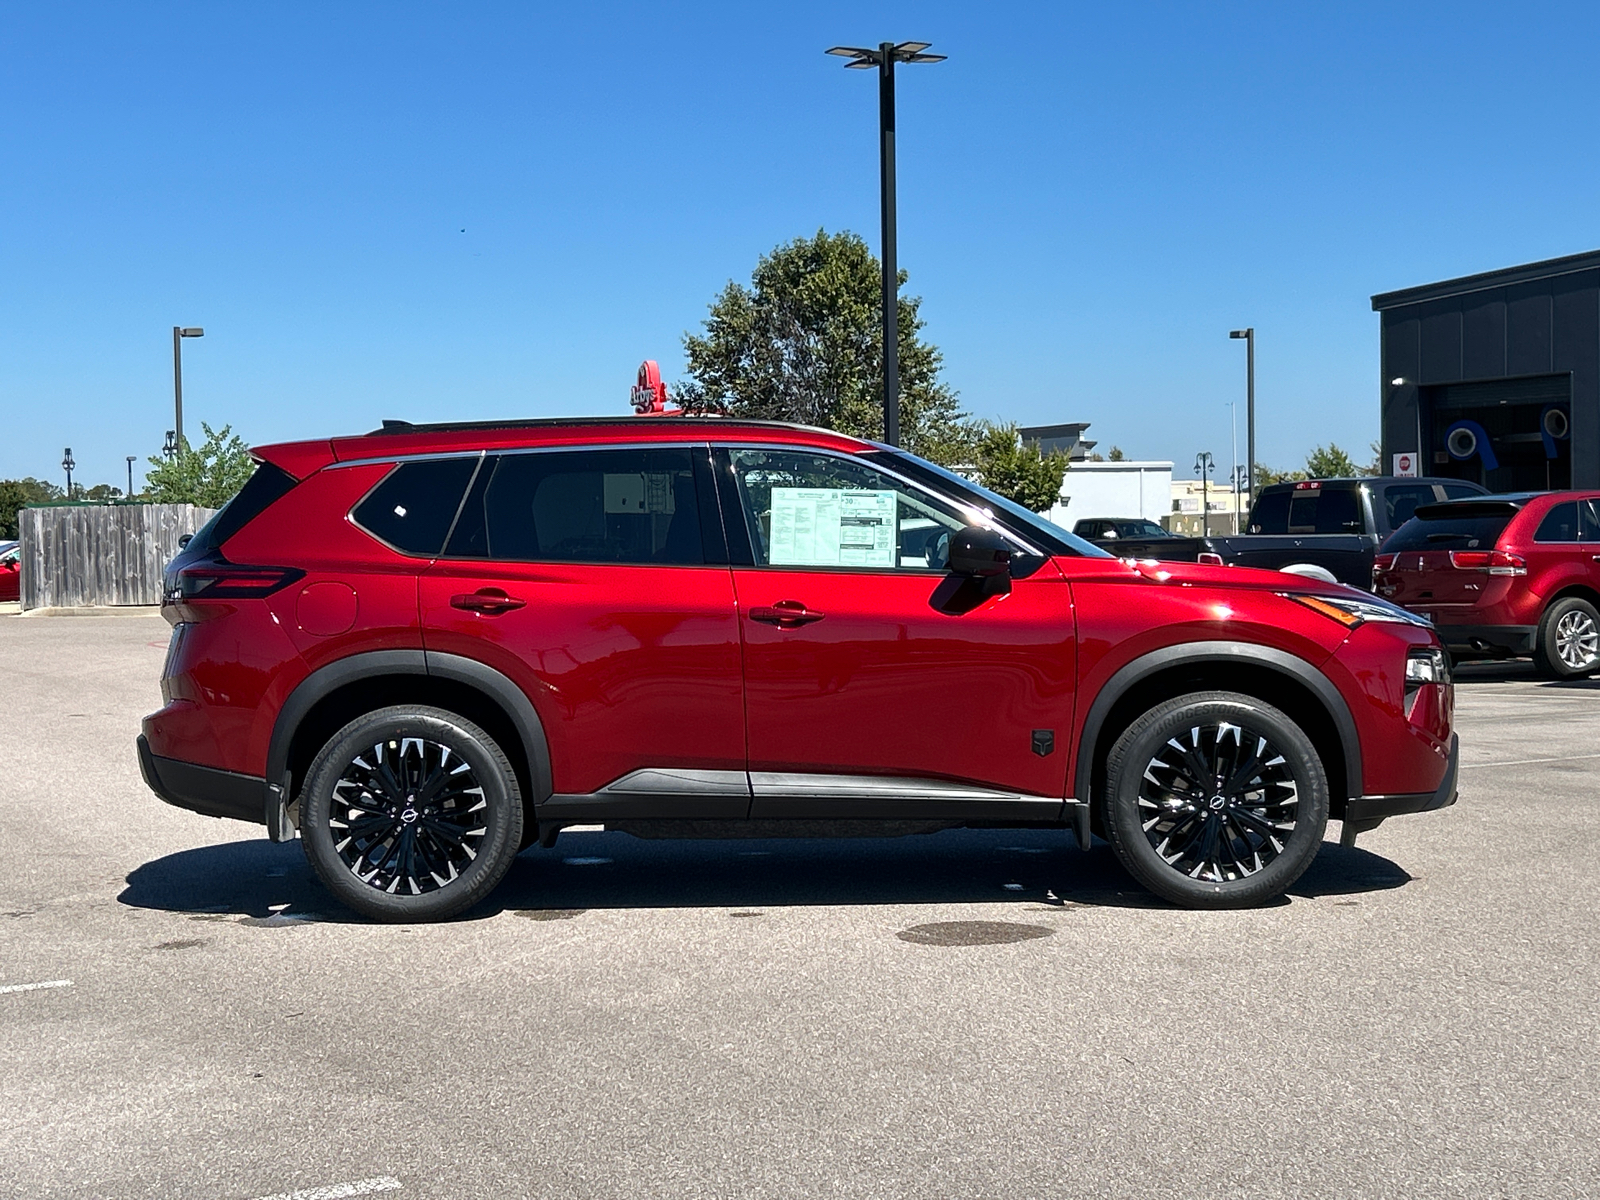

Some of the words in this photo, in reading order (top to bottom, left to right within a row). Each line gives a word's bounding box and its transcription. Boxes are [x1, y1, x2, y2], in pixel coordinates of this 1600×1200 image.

[1153, 703, 1245, 738] BRIDGESTONE
[1299, 751, 1320, 811] ALENZA
[460, 805, 507, 895] BRIDGESTONE
